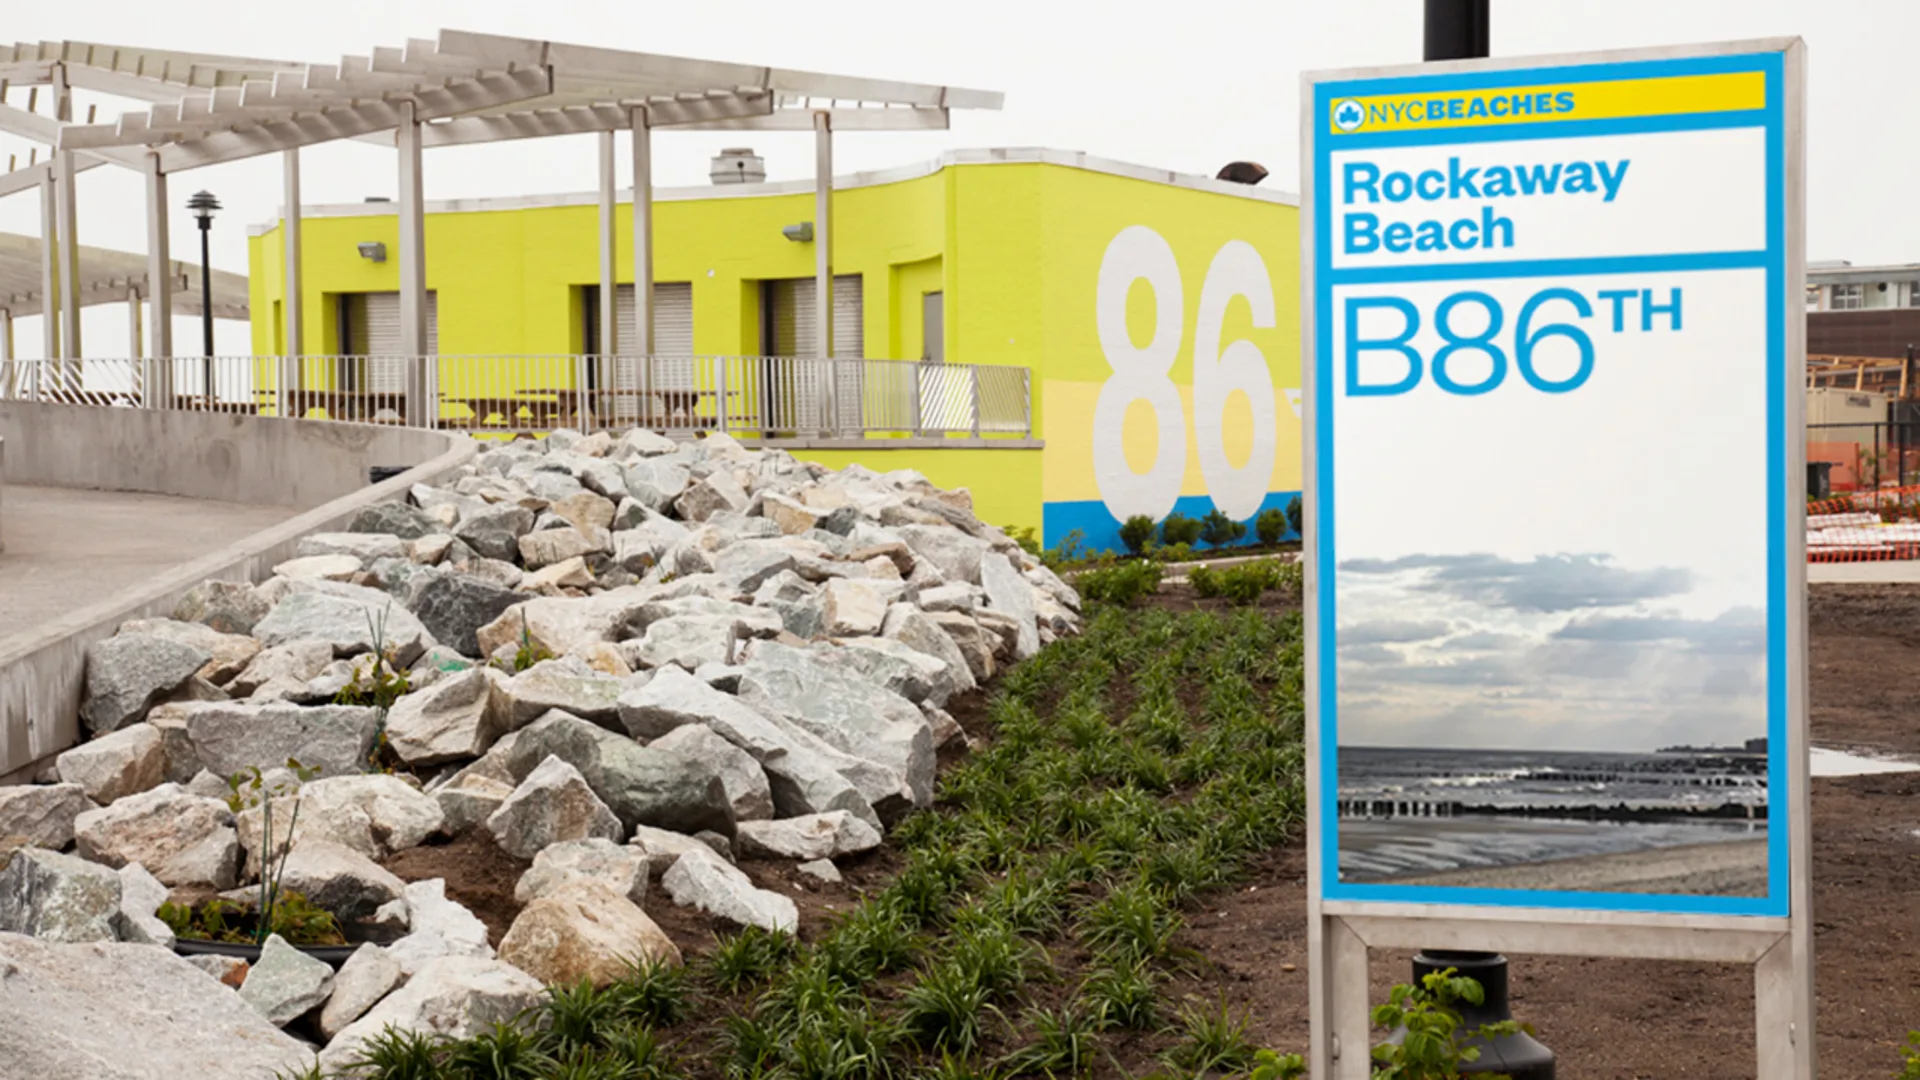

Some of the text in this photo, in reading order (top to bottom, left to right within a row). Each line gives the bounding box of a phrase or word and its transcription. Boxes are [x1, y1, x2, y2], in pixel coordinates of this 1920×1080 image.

[1343, 157, 1630, 204] Rockaway
[1343, 206, 1514, 254] Beach
[1093, 225, 1276, 525] 86
[1345, 287, 1682, 396] B86TH
